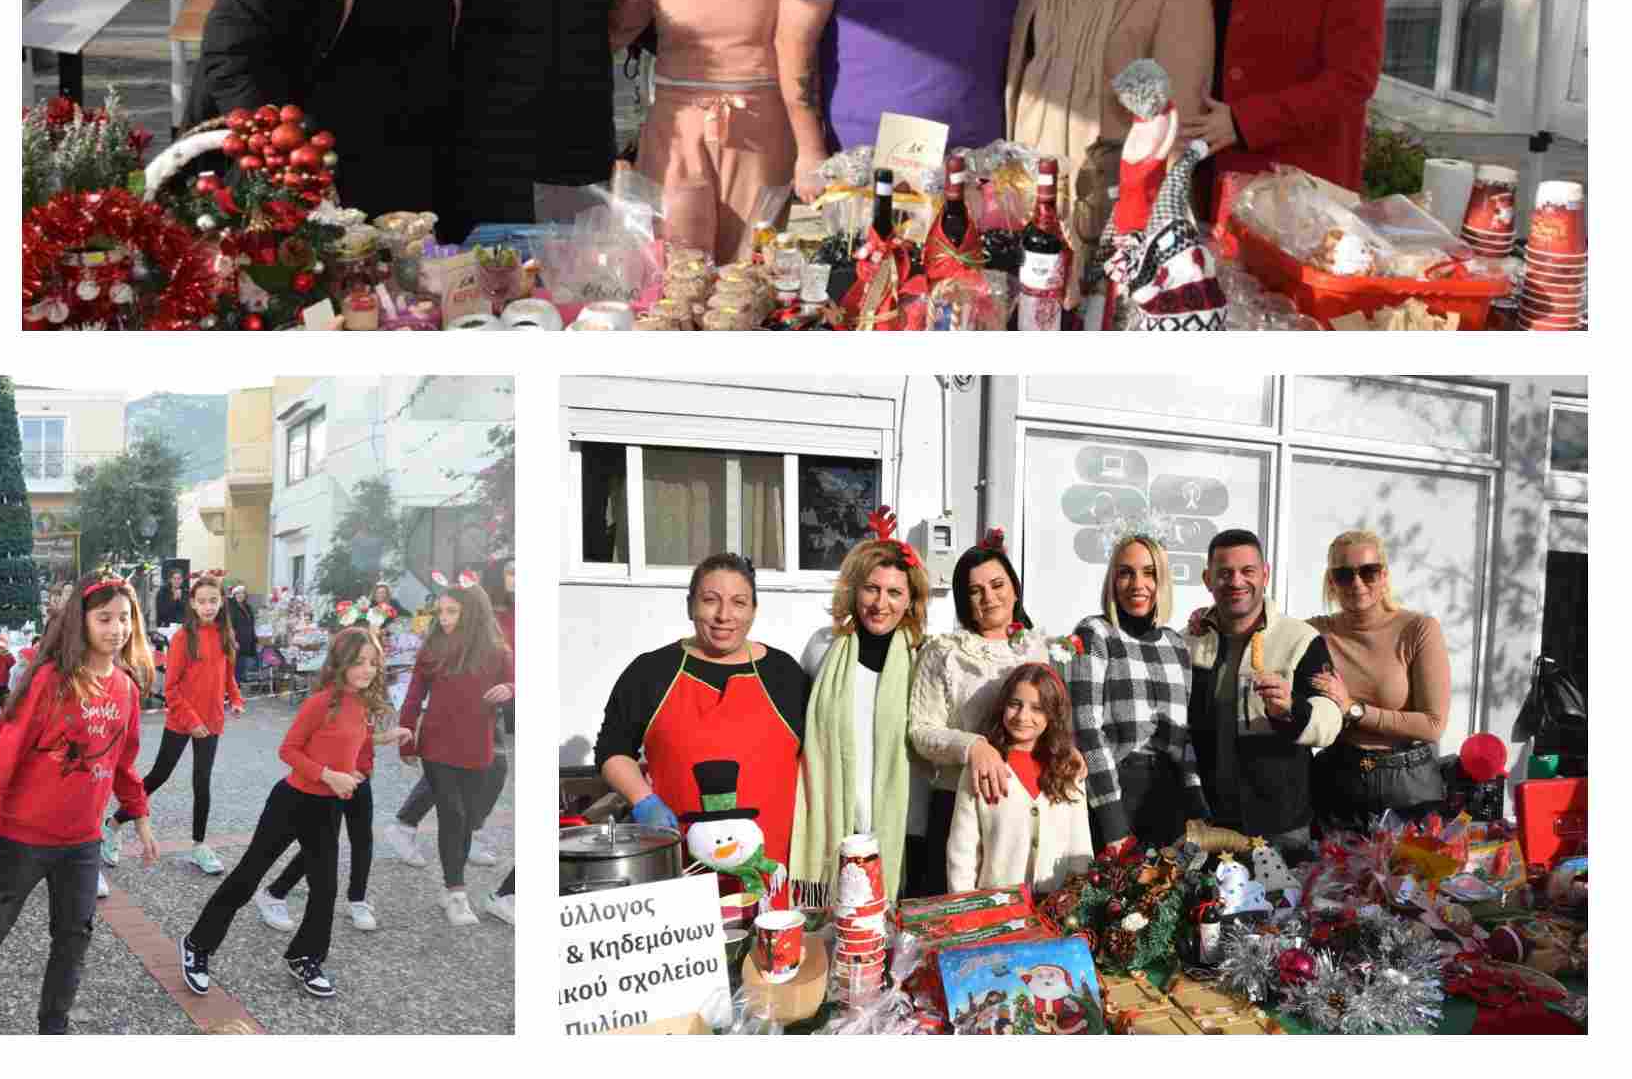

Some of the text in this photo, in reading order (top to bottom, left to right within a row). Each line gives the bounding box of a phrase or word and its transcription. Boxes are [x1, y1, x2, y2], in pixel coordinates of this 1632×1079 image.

[559, 897, 656, 928] ύλλογος
[566, 921, 716, 965] & Κηδεμόνων
[558, 955, 719, 1007] ικού σχολείου
